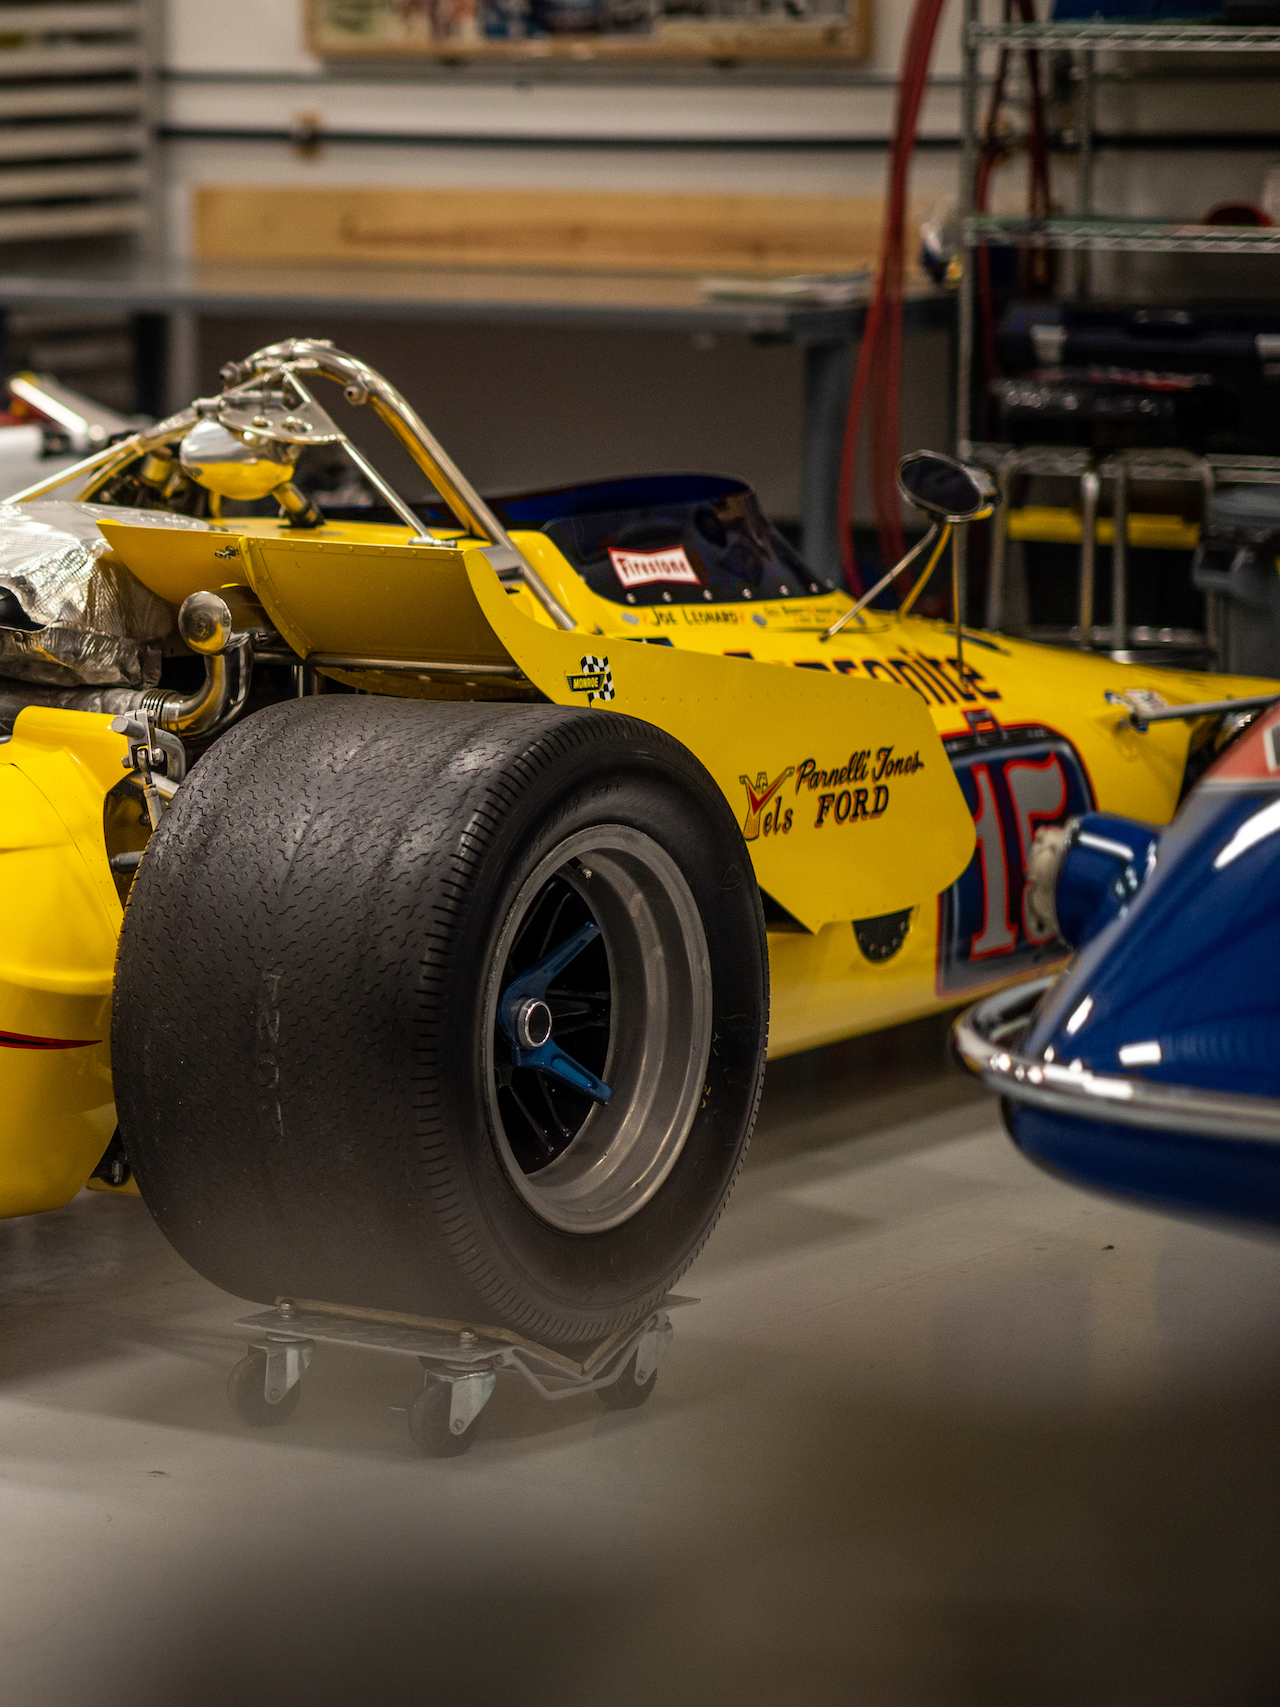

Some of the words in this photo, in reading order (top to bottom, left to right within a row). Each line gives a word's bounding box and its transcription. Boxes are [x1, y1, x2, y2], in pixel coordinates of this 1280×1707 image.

[617, 558, 688, 579] Firestone
[650, 606, 677, 626] JOE
[681, 606, 738, 626] LEONARD
[573, 676, 599, 689] MONROE
[795, 749, 871, 796] Parnelli
[872, 745, 924, 784] Jones
[814, 785, 889, 829] FORD
